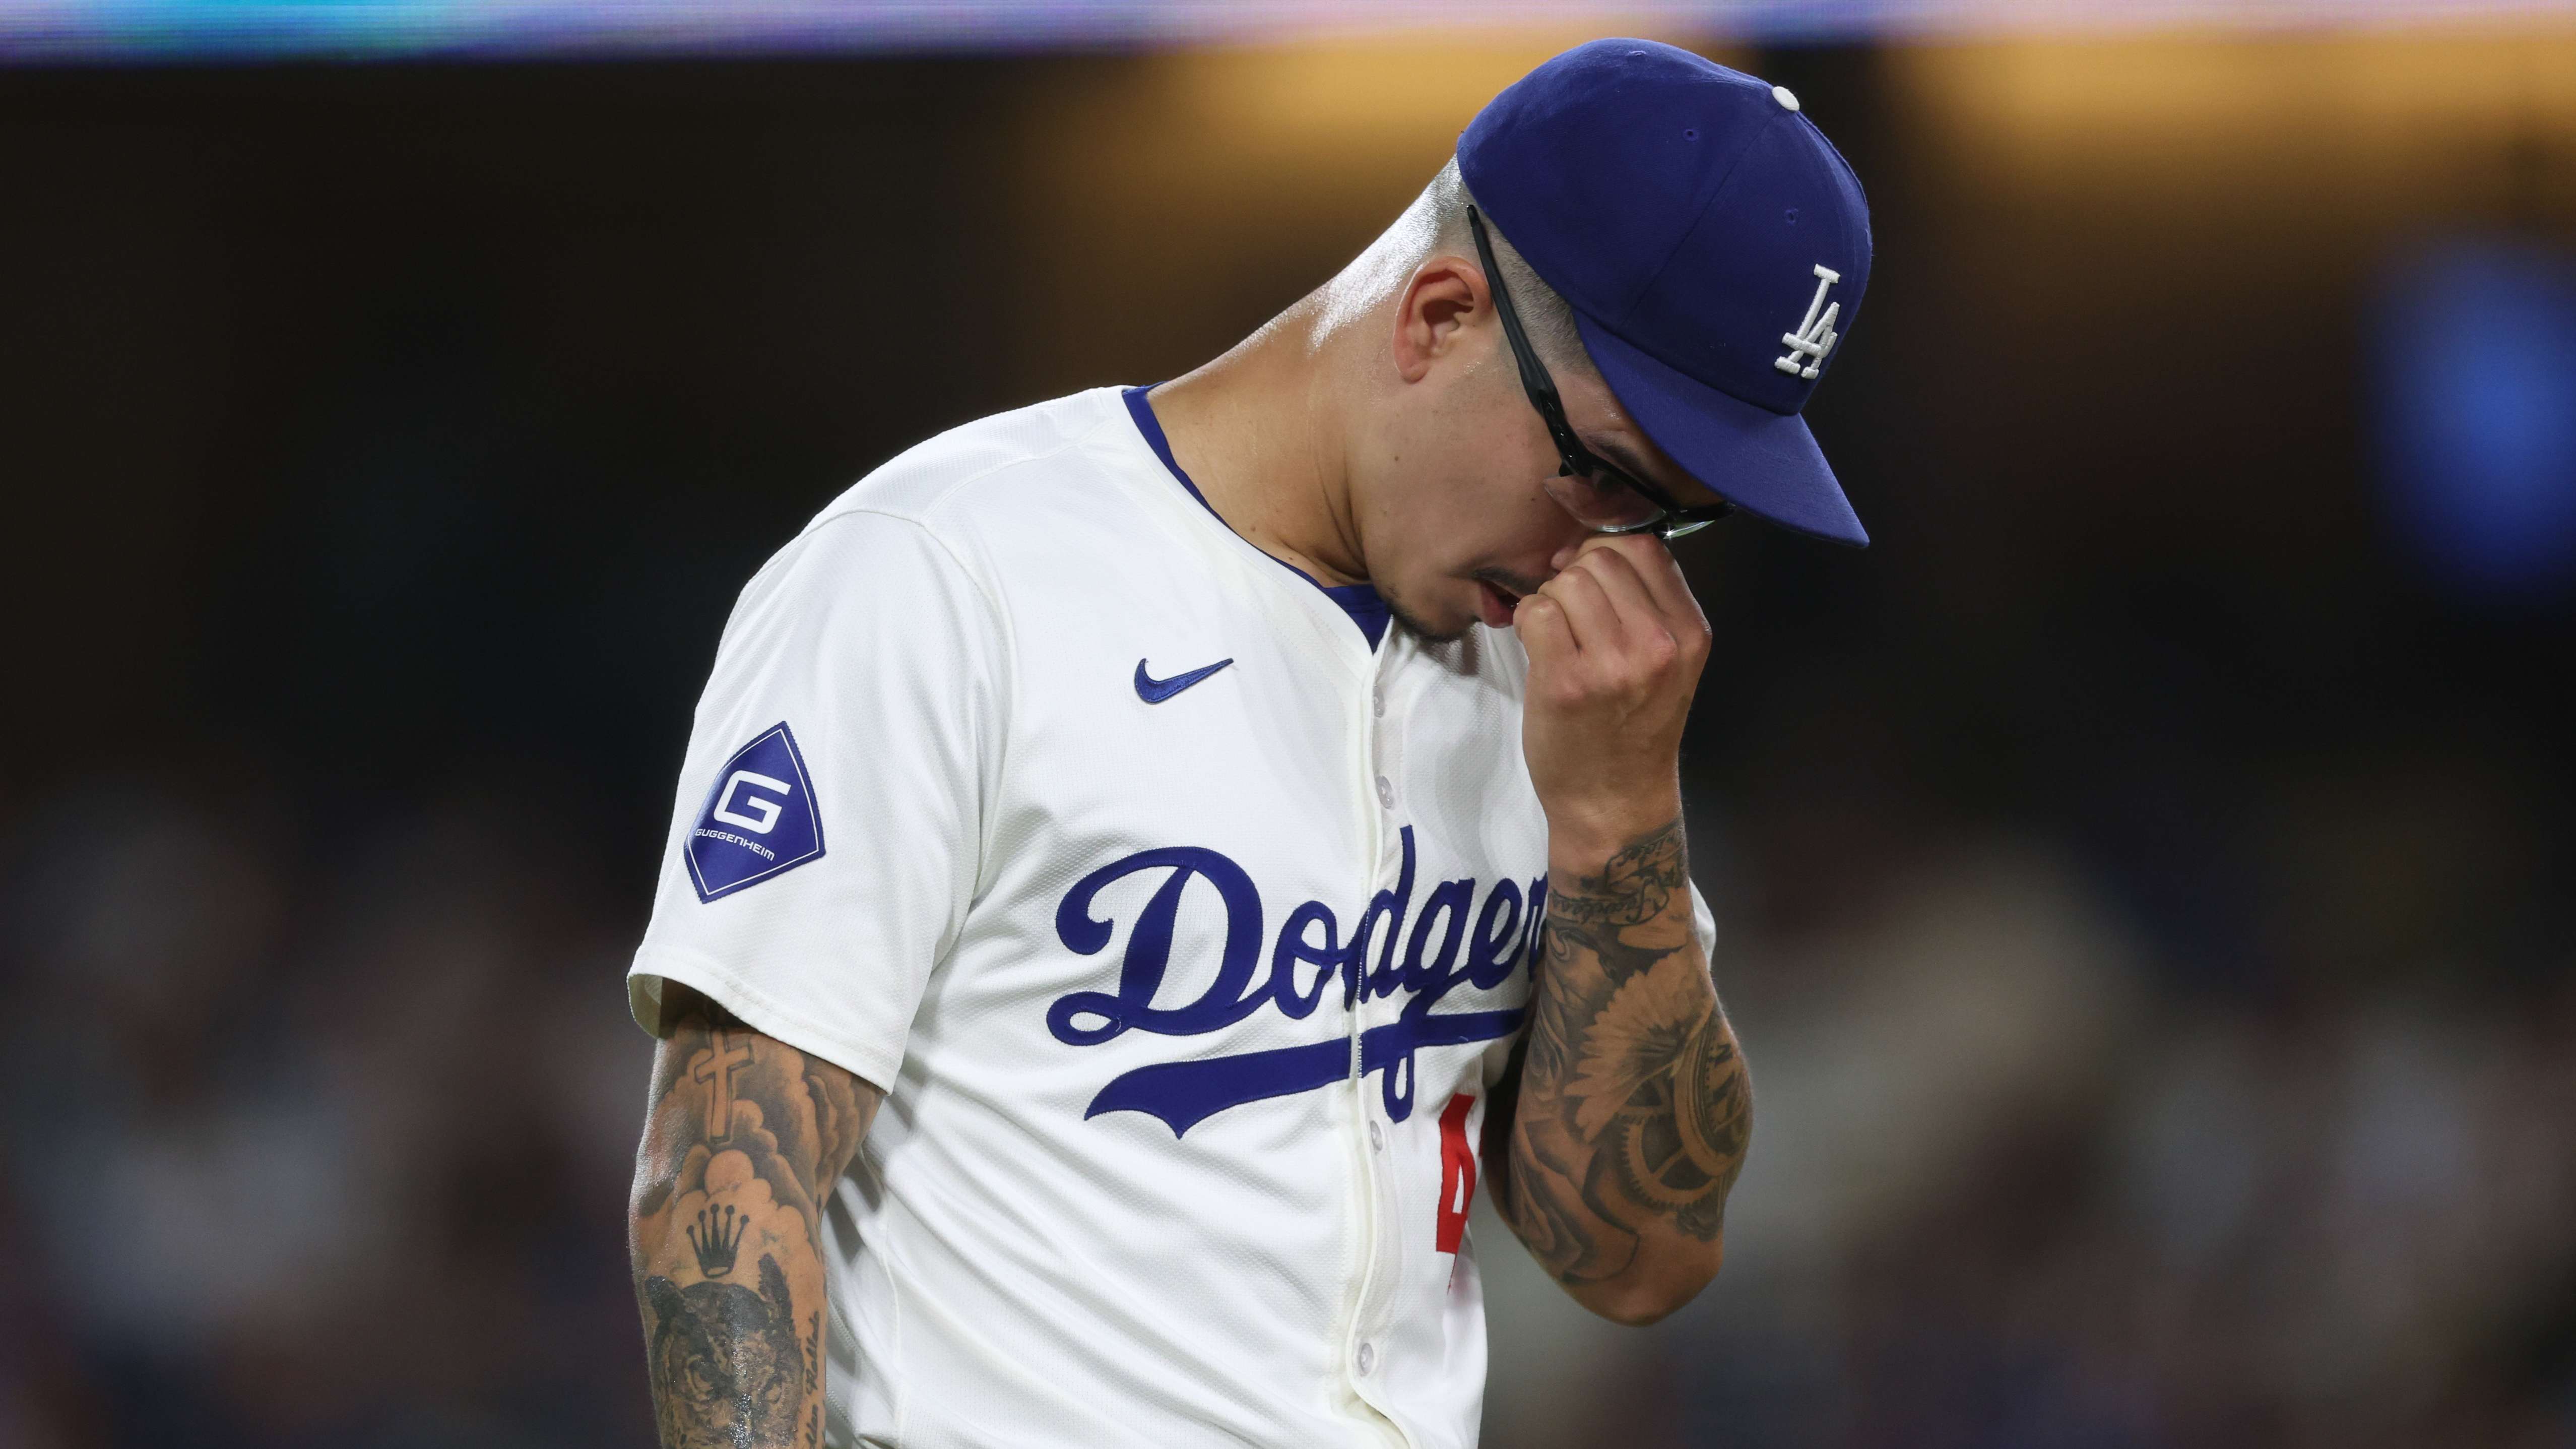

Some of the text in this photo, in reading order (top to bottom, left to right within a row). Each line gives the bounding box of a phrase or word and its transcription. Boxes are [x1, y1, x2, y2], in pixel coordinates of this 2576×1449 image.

[1774, 263, 1841, 380] LA
[695, 828, 775, 861] GUGGENHEIM
[714, 770, 791, 835] G
[1046, 824, 1549, 1124] Dodger
[1436, 1092, 1484, 1294] 4
